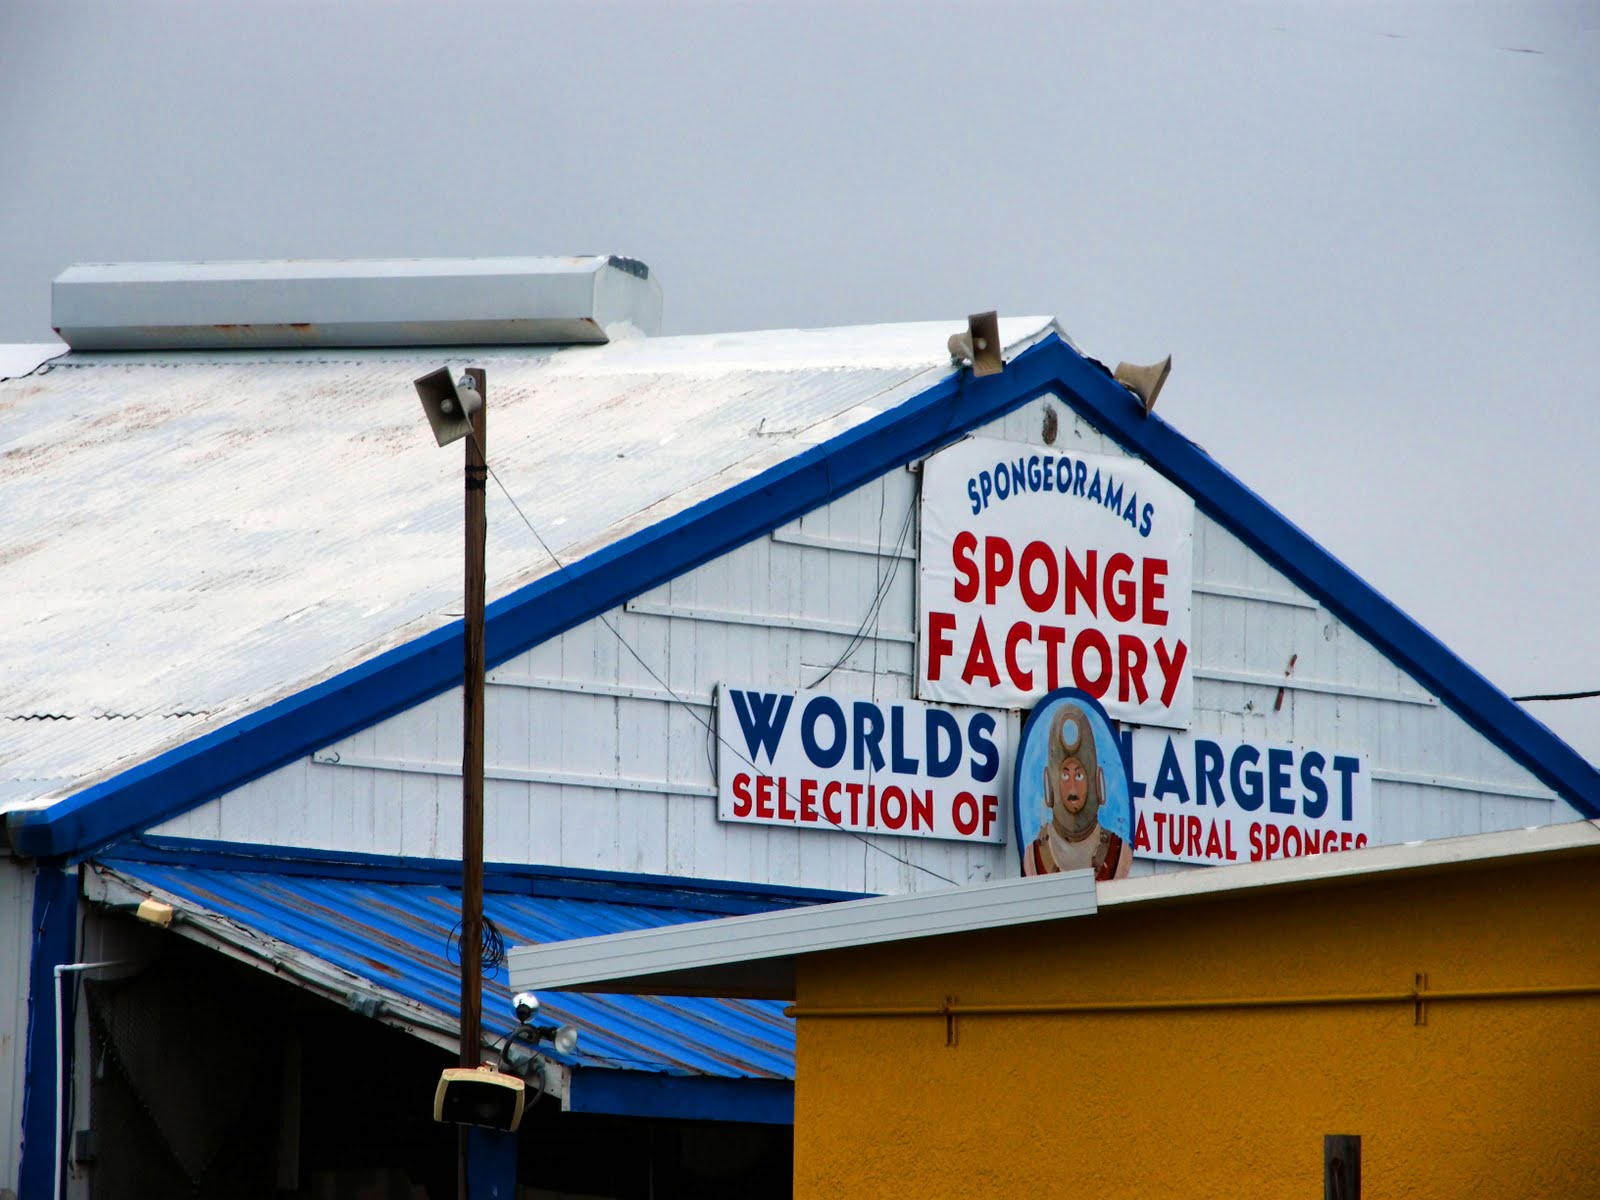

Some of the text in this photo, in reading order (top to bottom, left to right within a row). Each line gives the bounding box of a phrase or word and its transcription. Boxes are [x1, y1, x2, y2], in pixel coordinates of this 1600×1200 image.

[968, 455, 1154, 537] SPONGEORAMAS
[952, 531, 1169, 626] SPONGE
[927, 611, 1187, 708] FACTORY
[729, 689, 1000, 783] WORLDS
[1121, 731, 1360, 821] LARGEST
[732, 773, 999, 836] SELECTION OF
[1134, 810, 1238, 861] ATURAL
